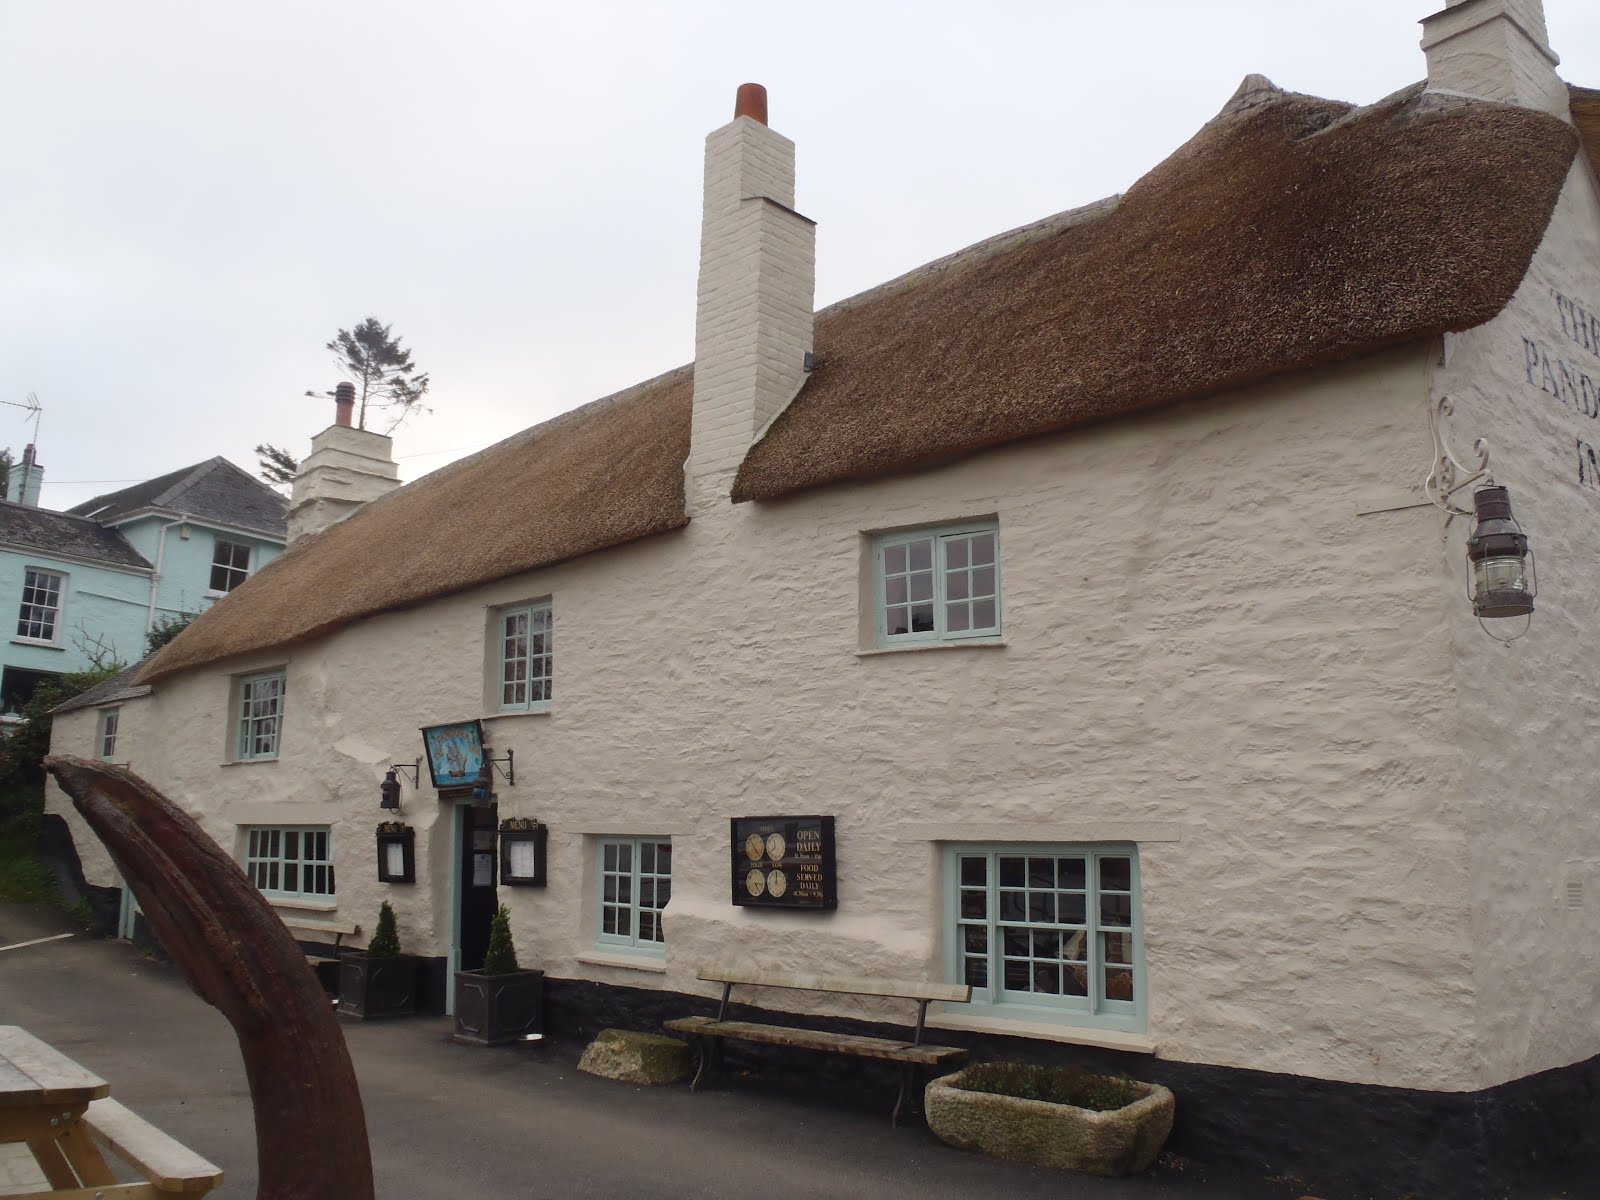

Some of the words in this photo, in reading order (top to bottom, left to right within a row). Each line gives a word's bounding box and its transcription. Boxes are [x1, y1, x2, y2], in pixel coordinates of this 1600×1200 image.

[1520, 334, 1600, 419] PAND
[510, 820, 527, 830] MENU
[796, 830, 820, 840] OPEN
[796, 842, 821, 852] DAILY
[800, 864, 819, 872] FOOD
[796, 873, 823, 881] SERVED
[800, 881, 819, 890] DAILY
